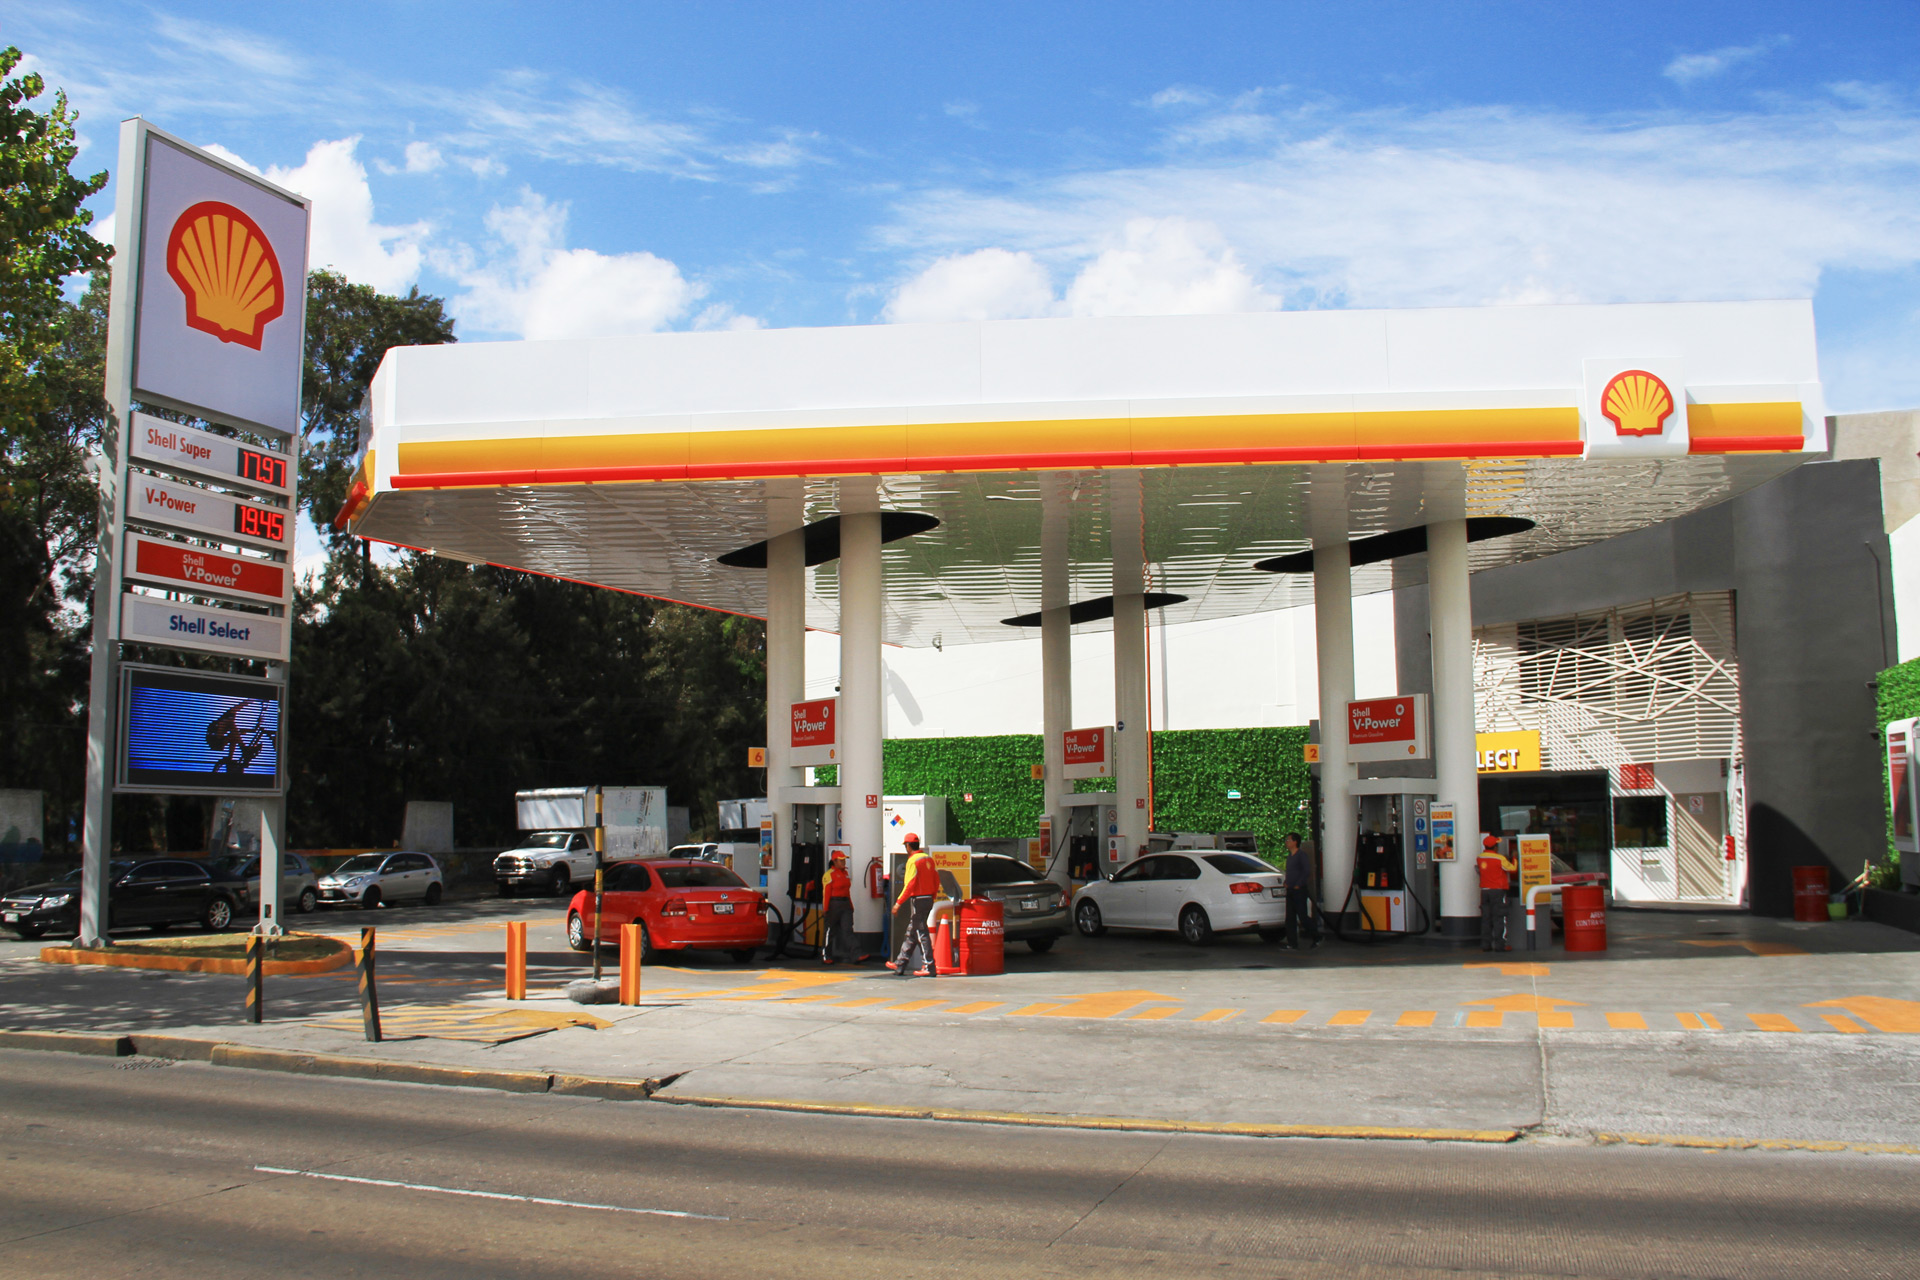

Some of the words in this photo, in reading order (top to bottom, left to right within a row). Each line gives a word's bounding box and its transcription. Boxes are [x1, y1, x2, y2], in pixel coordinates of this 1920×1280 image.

[147, 428, 177, 450] Shell
[180, 437, 211, 460] Super
[242, 451, 286, 487] 17.97
[145, 487, 196, 514] V-Power
[240, 505, 284, 541] 19.45
[183, 554, 204, 566] Shell
[183, 565, 237, 587] V-Power
[169, 615, 205, 634] Shell
[209, 620, 250, 641] Select
[794, 709, 807, 720] Shell
[1352, 707, 1370, 718] Shell
[794, 720, 827, 733] V-Power
[1353, 717, 1401, 731] V-Power
[1066, 735, 1077, 744] Shell
[1066, 743, 1096, 754] V-Power
[1310, 749, 1317, 758] 2
[755, 752, 762, 762] 6
